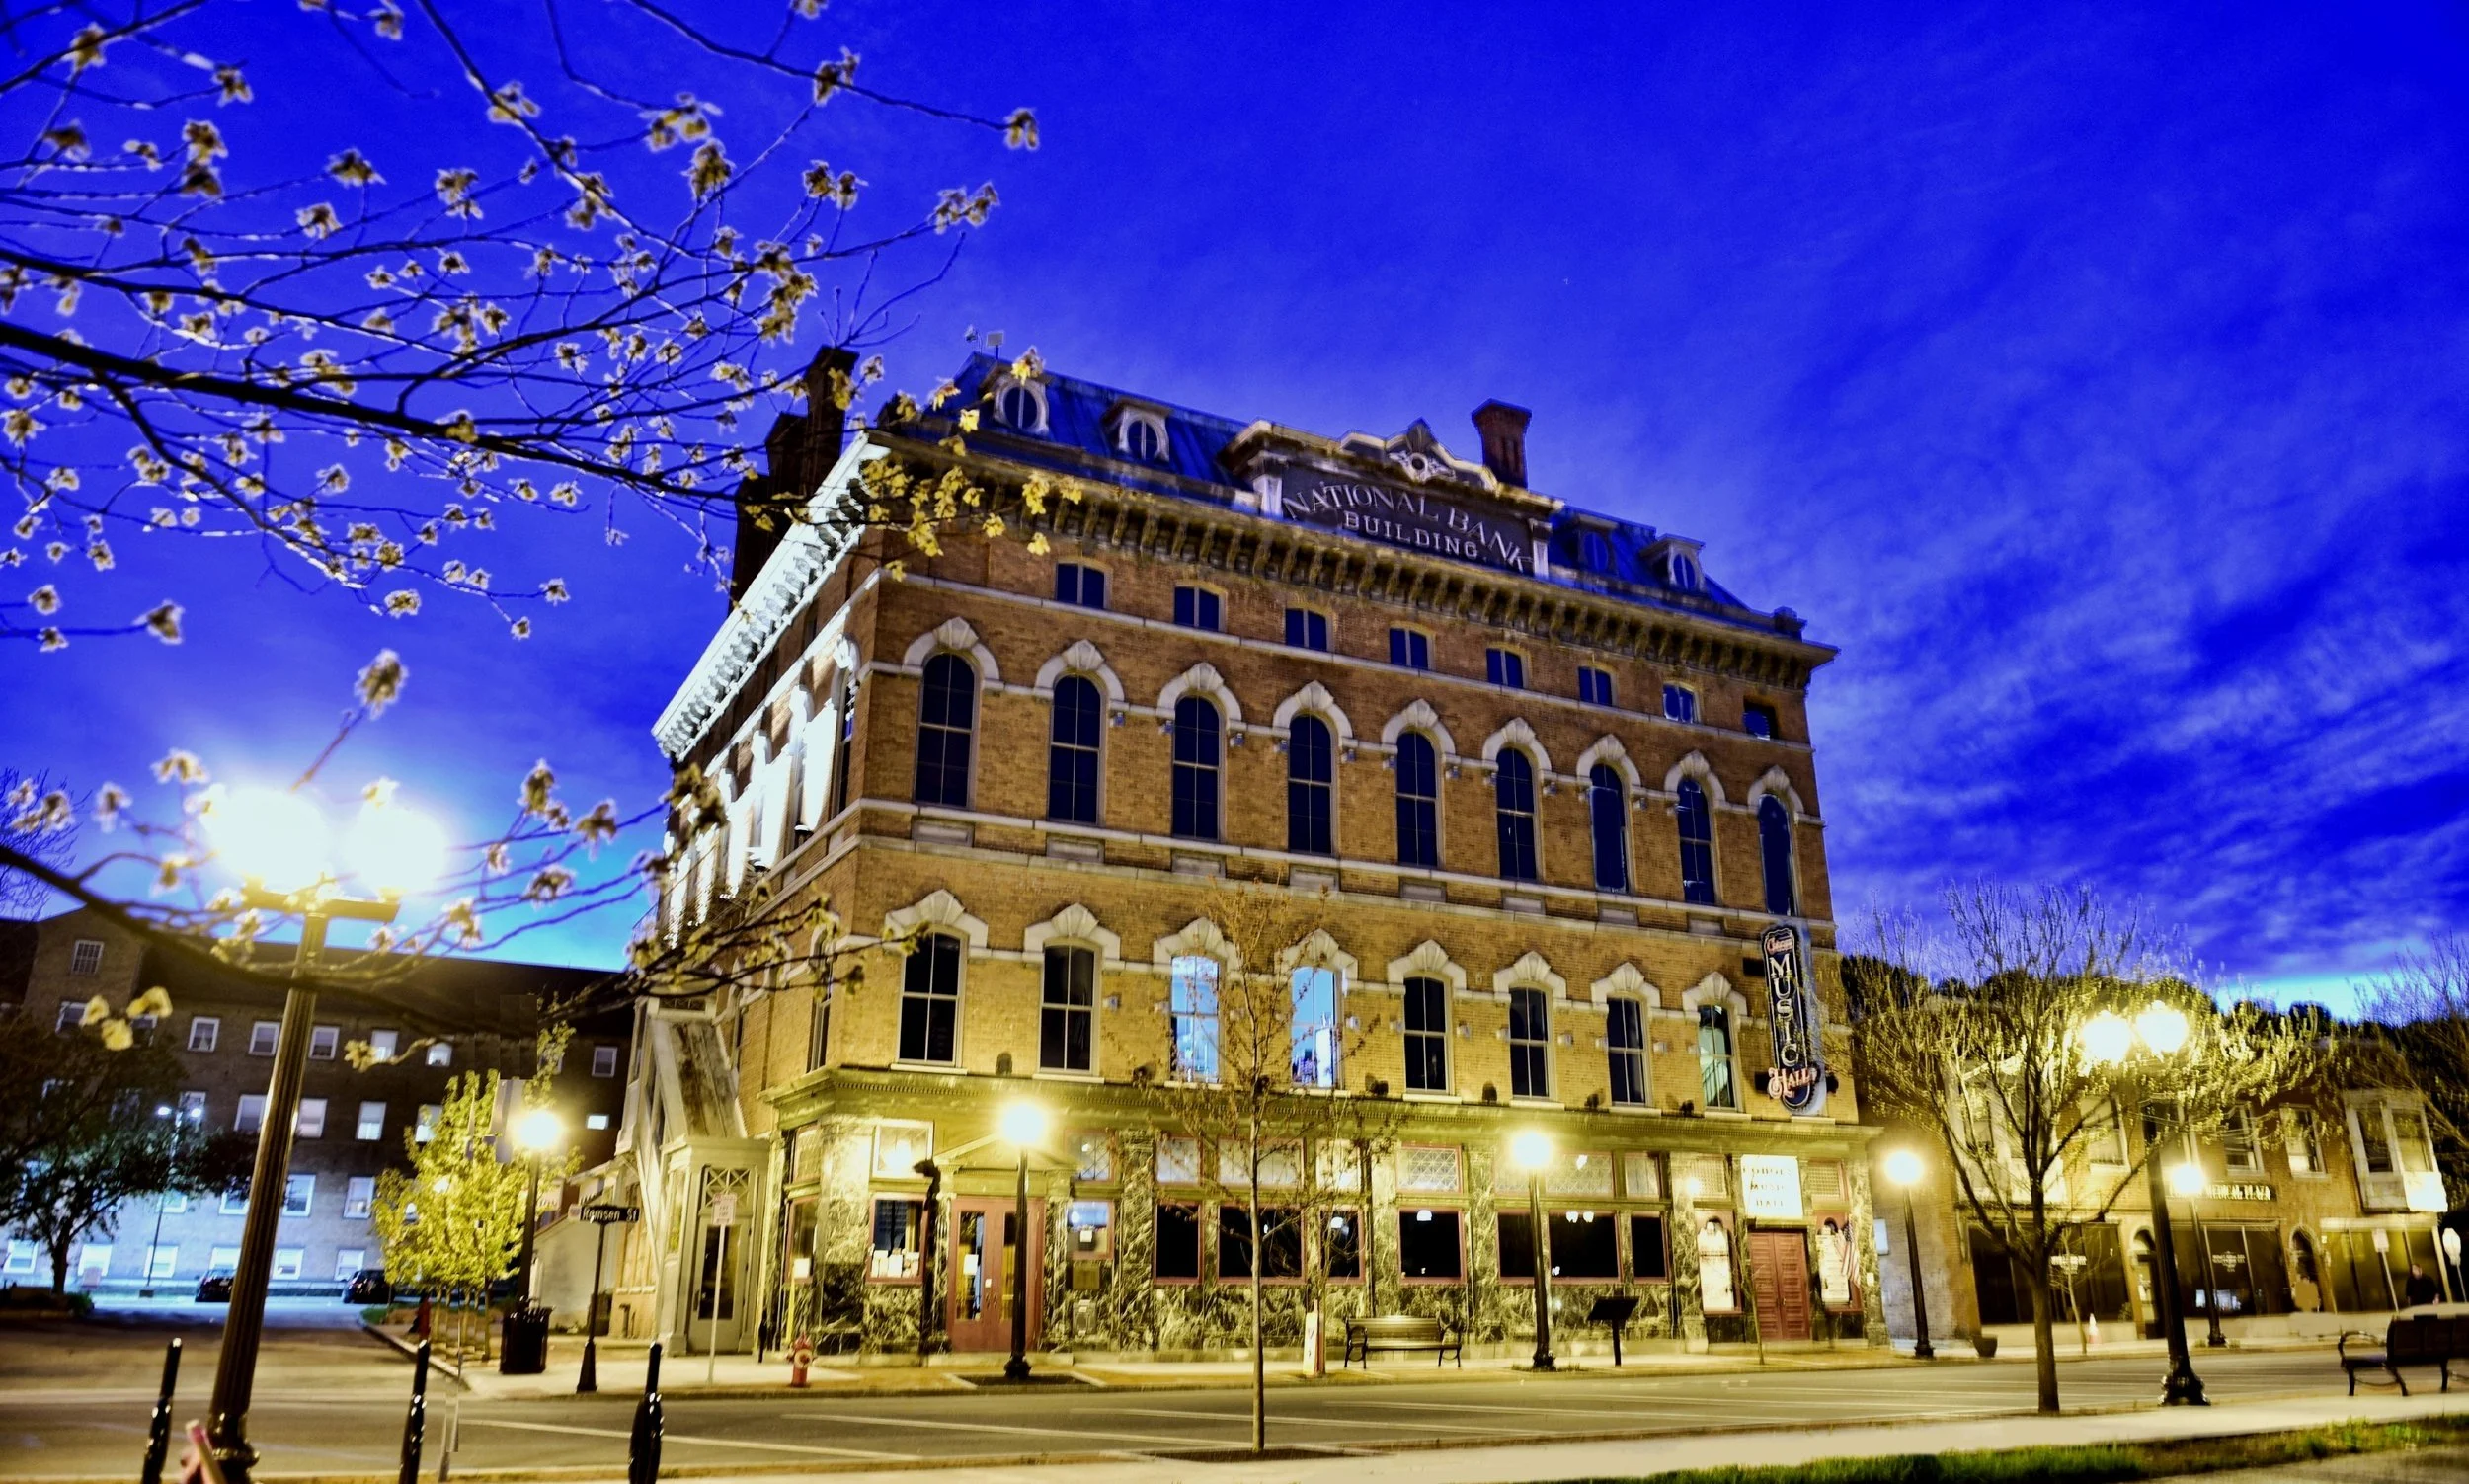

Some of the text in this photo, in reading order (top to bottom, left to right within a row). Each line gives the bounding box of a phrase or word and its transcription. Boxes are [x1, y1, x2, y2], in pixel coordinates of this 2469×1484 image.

[1282, 483, 1534, 572] NATIONAL BANK
[1769, 953, 1800, 1067] MUSIC
[626, 1208, 637, 1222] St
[2244, 1185, 2270, 1200] PLAZA
